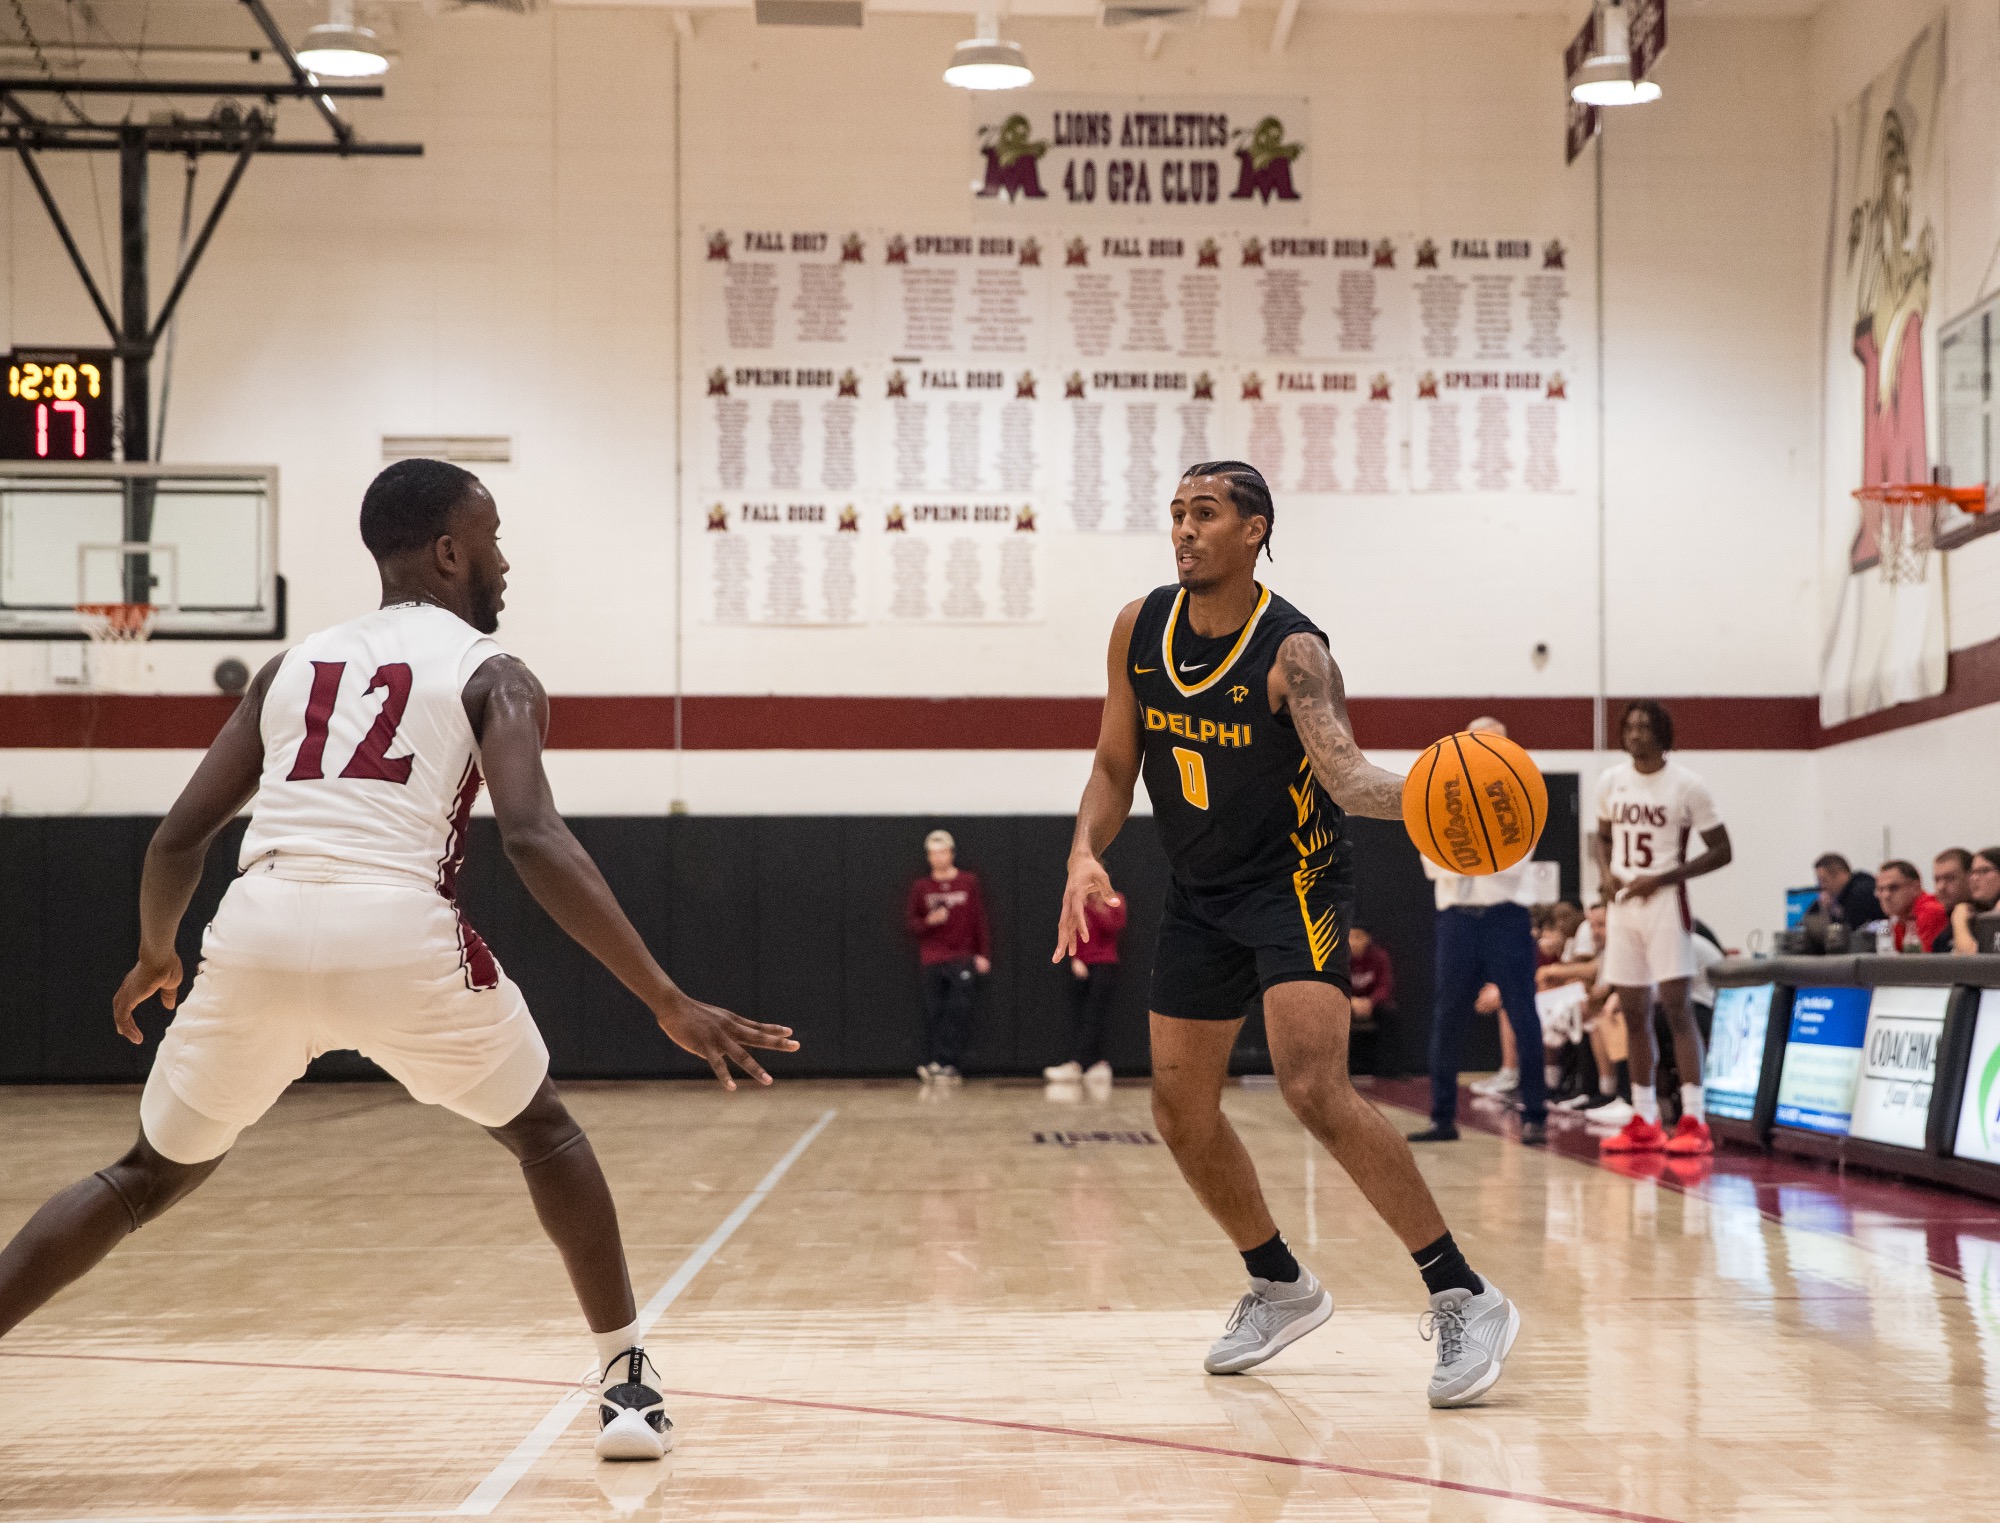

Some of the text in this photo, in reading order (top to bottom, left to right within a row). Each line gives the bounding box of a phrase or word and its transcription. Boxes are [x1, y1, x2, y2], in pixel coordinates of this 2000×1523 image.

[1054, 111, 1228, 148] LIONS ATHLETICS
[1108, 159, 1150, 204] GPA
[1162, 160, 1219, 204] CLUB
[1102, 237, 1142, 258] FALL
[1270, 237, 1328, 258] SPRING
[1451, 239, 1489, 259] FALL
[9, 362, 101, 400] 12:07
[921, 370, 958, 389] FALL
[1093, 371, 1148, 390] SPRING
[1277, 372, 1315, 391] FALL
[1445, 372, 1499, 390] SPRING
[35, 400, 86, 457] 17
[741, 503, 780, 522] FALL
[912, 504, 967, 522] SPRING
[285, 660, 416, 786] 12
[1139, 701, 1253, 748] DELPHI
[1172, 746, 1210, 811] 0
[1444, 773, 1483, 868] Wilson
[1485, 779, 1521, 847] NCAA
[1612, 802, 1667, 828] LIONS
[1622, 830, 1653, 868] 15
